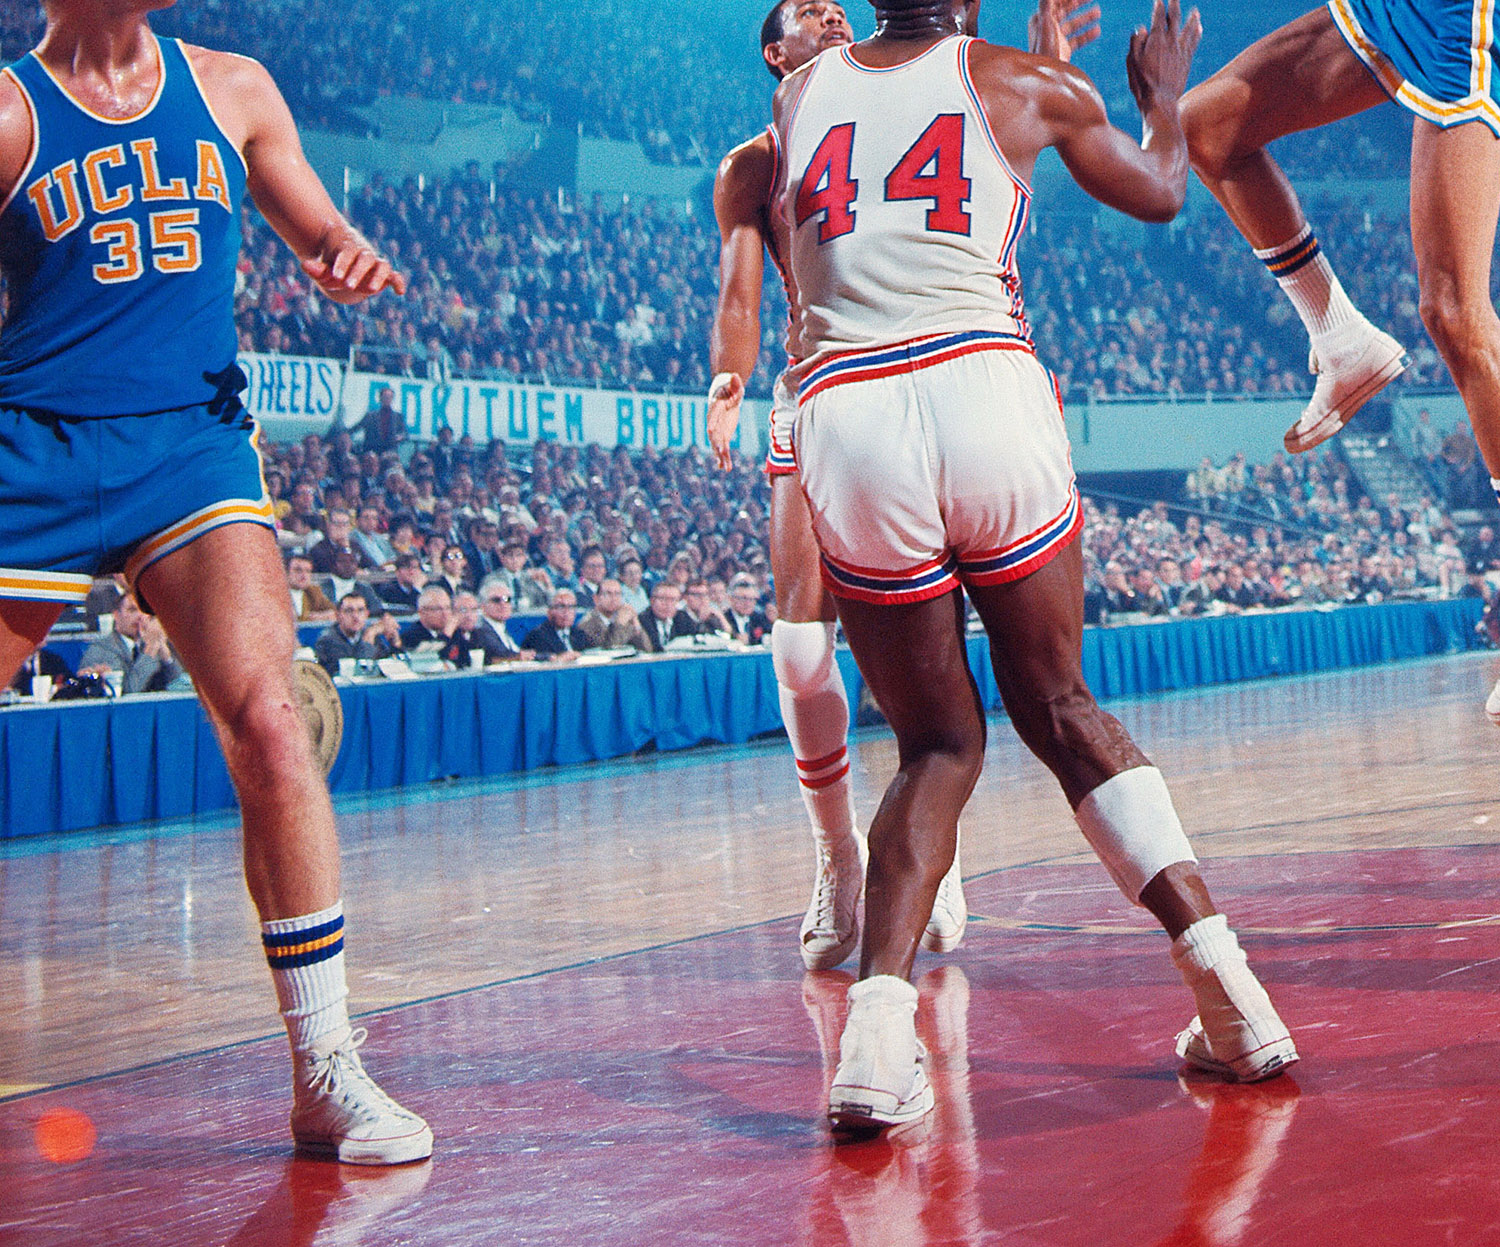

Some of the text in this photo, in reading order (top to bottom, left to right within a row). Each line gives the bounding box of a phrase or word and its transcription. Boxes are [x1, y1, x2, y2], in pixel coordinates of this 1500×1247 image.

[26, 137, 232, 243] UCLA
[794, 112, 972, 246] 44
[89, 208, 202, 285] 35
[616, 397, 741, 448] BRUI
